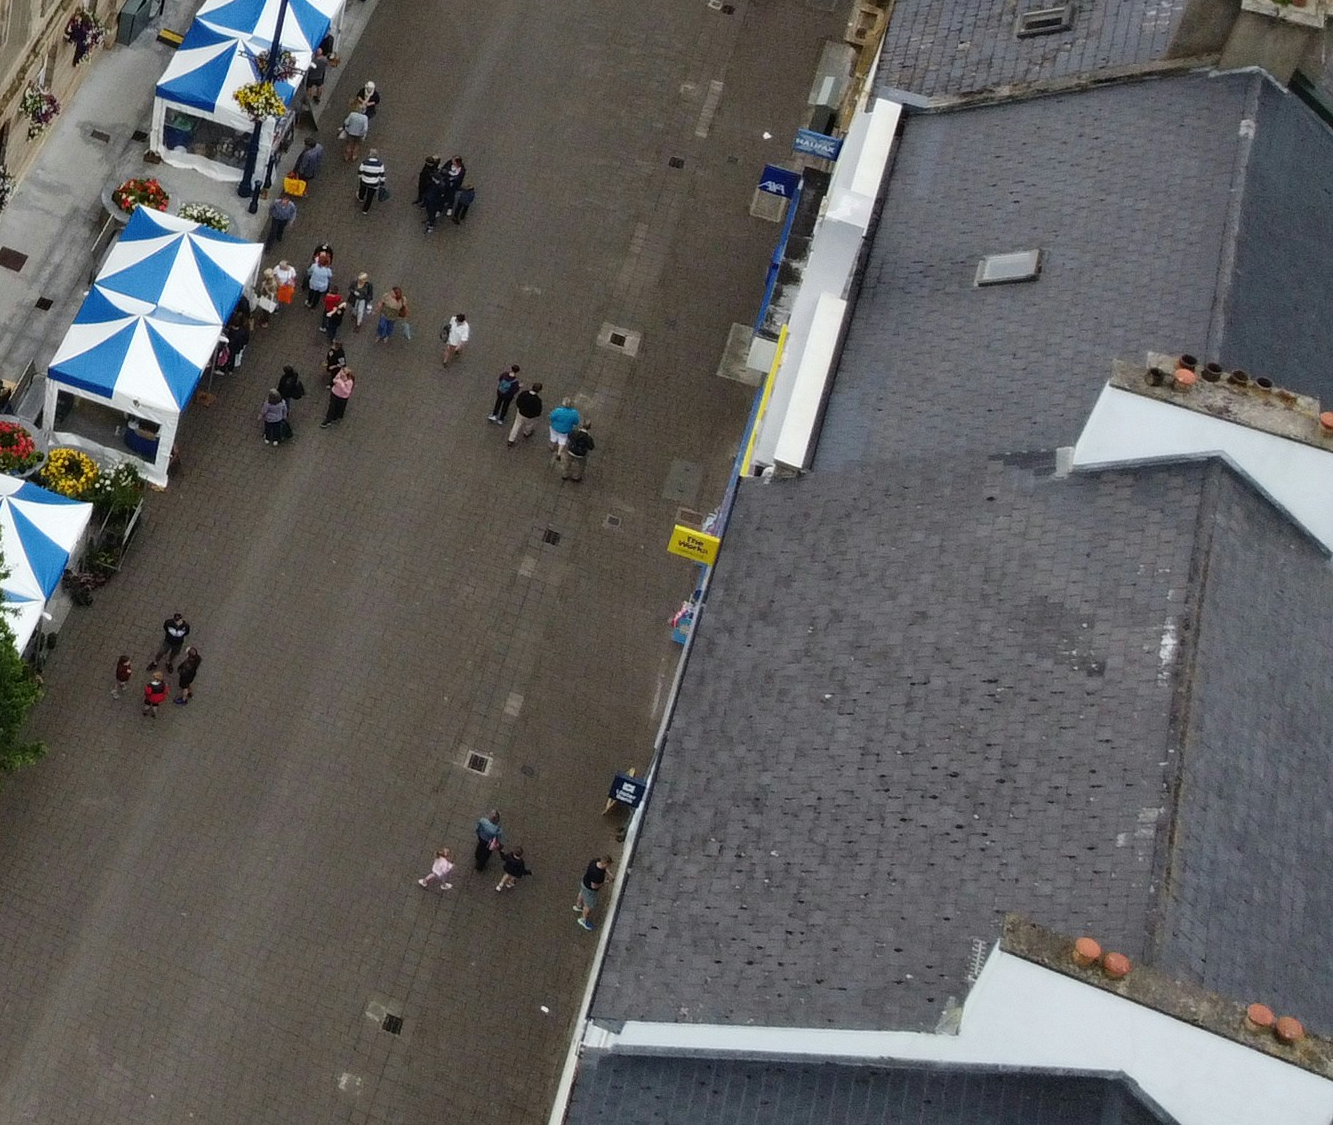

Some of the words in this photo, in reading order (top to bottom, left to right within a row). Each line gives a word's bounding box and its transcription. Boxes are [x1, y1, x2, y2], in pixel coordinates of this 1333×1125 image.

[795, 138, 836, 154] HALIFAX
[759, 180, 786, 195] AXA
[687, 536, 704, 546] The
